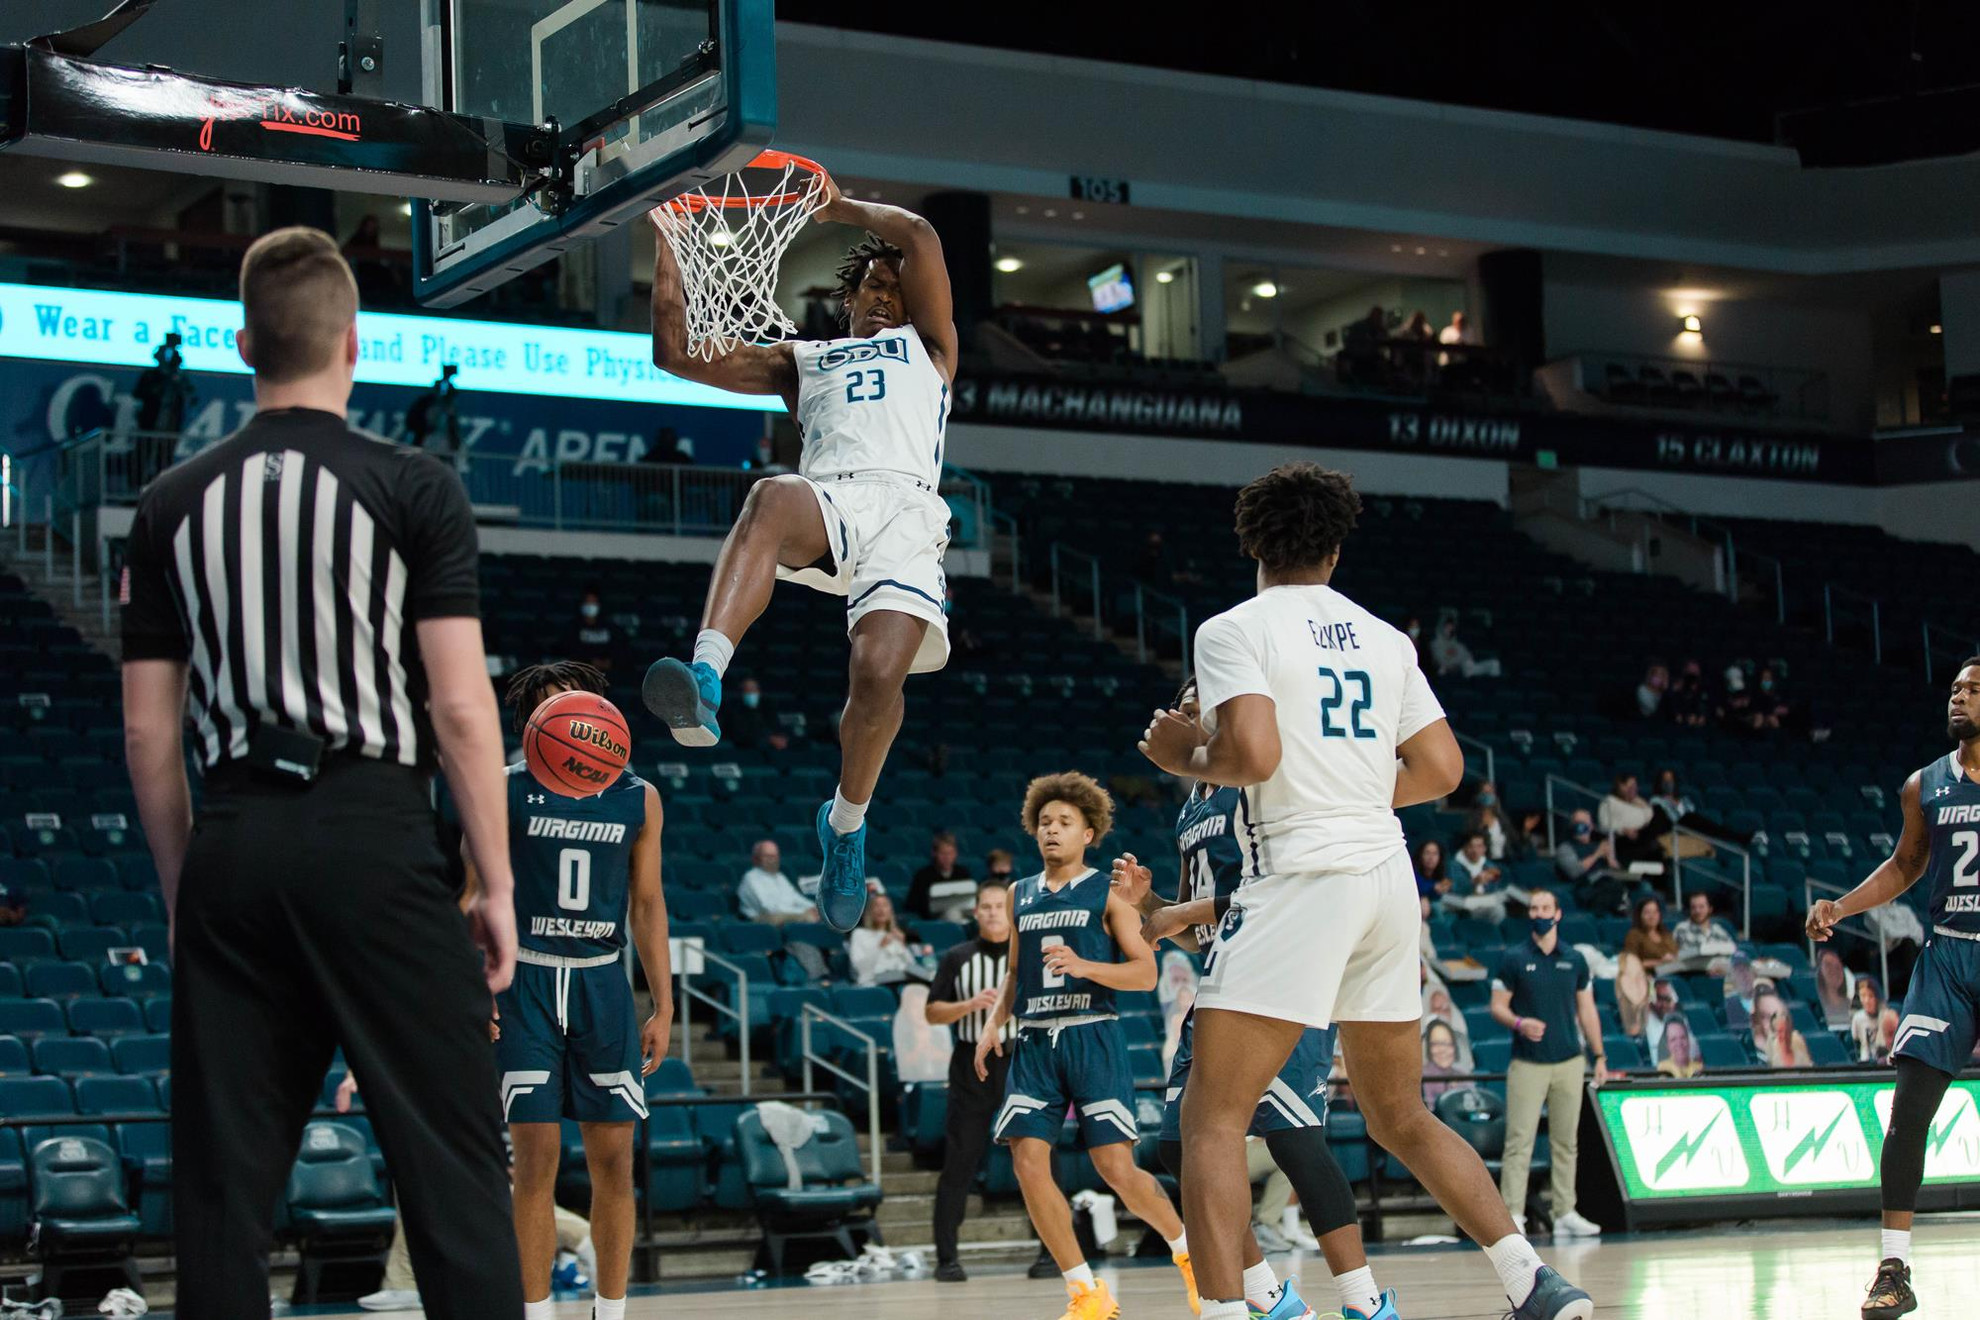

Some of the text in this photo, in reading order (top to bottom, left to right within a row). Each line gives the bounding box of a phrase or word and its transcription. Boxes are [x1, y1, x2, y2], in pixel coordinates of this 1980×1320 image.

[34, 304, 112, 341] Wear
[134, 321, 149, 343] a
[171, 314, 235, 349] Face
[421, 334, 506, 369] Please
[522, 342, 569, 375] Use
[587, 347, 680, 386] Physi
[818, 337, 909, 371] ODU
[846, 369, 886, 403] 23
[987, 384, 1242, 430] MACHANGUANA
[1389, 413, 1520, 447] 13 DIXON
[1657, 433, 1820, 471] 15 CLAXTON
[1318, 667, 1377, 738] 22
[569, 719, 627, 760] Wilson
[563, 756, 610, 785] NCAA
[527, 815, 626, 844] VIRGINIA
[1951, 830, 1979, 888] 2
[558, 848, 591, 912] 0
[531, 916, 616, 939] WESLEYAN
[1018, 909, 1091, 934] VIRGINIA
[1025, 993, 1092, 1015] WESLEYAN
